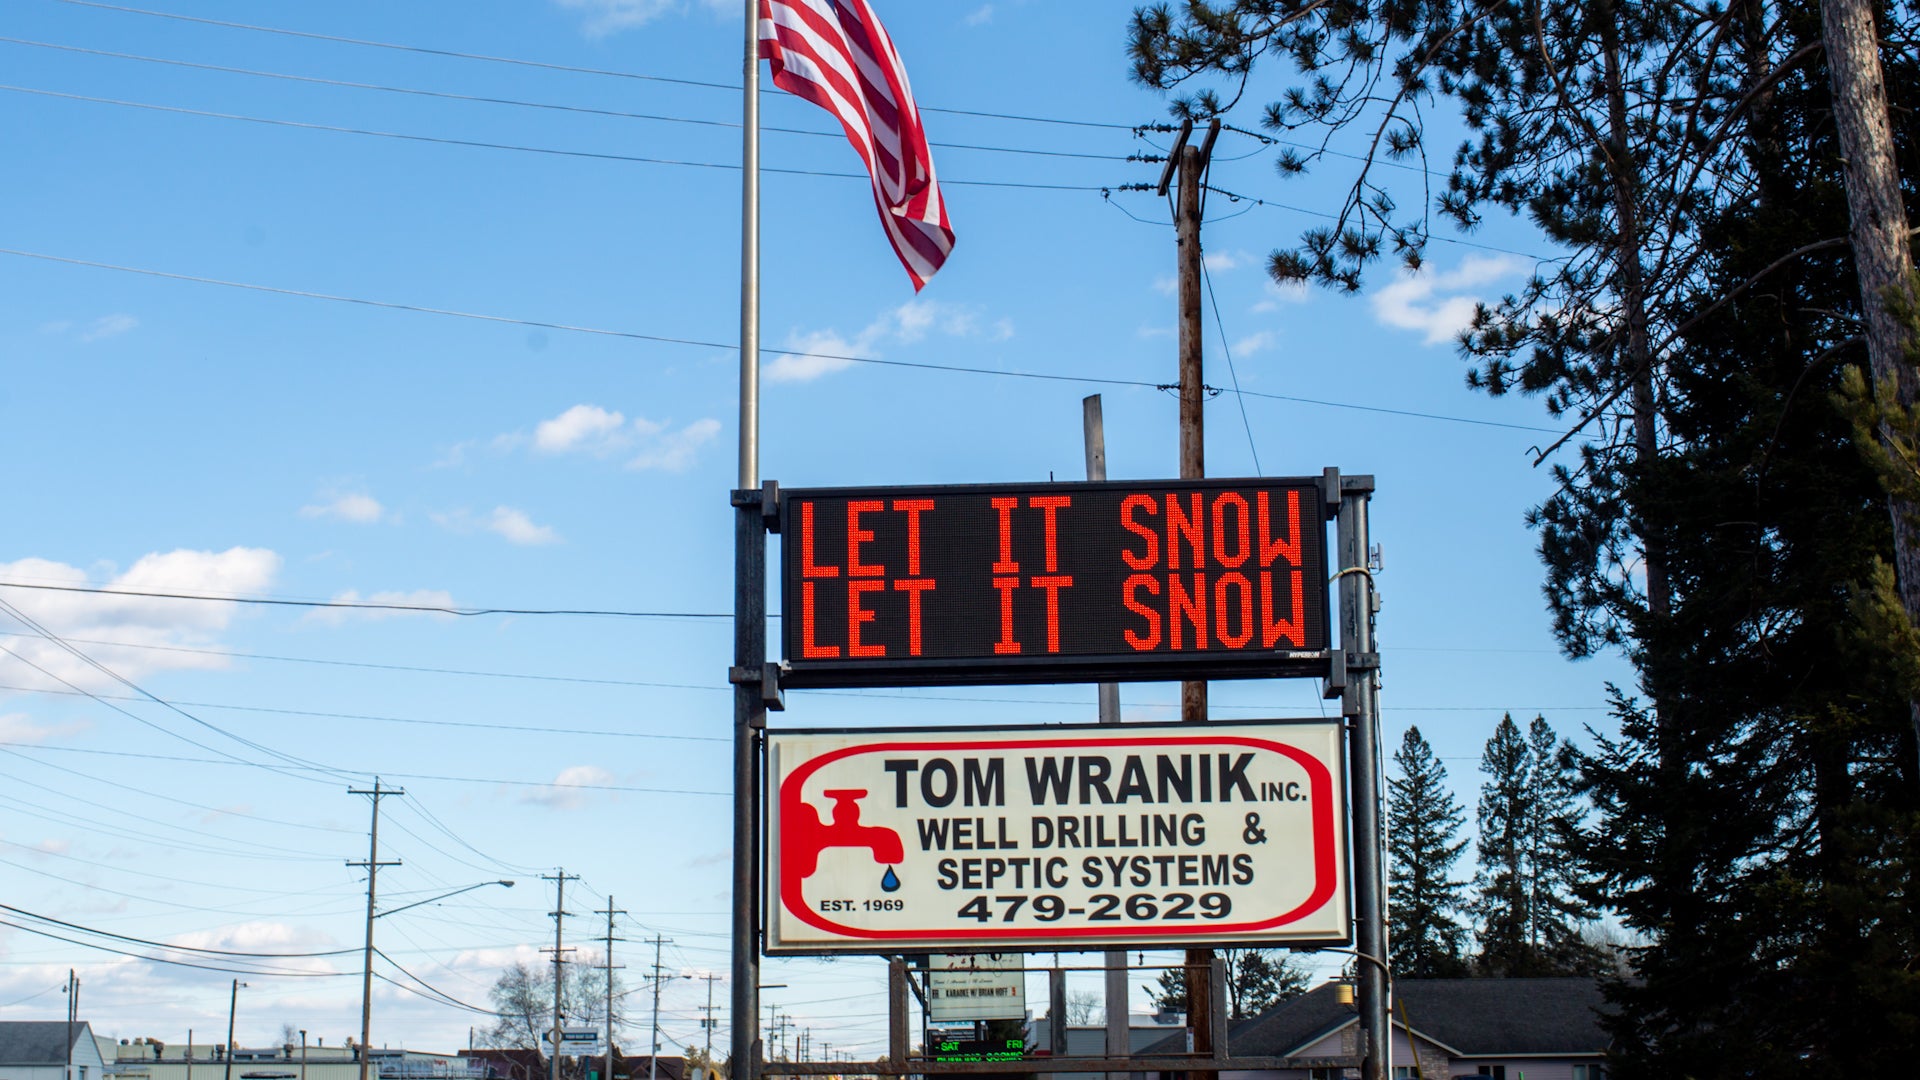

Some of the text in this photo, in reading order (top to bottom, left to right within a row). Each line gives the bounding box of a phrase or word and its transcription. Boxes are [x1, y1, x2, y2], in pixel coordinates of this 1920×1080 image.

[802, 491, 1301, 578] LET IT SNOW
[803, 571, 1304, 658] LET IT SNOW
[885, 753, 1307, 808] TOM WRANIK INC.
[917, 812, 1267, 850] WELL DRILLING &
[938, 854, 1254, 890] SEPTIC SYSTEMS
[820, 899, 904, 912] EST. 1969
[957, 892, 1232, 923] 479-2629
[946, 988, 969, 998] KARAOKE
[941, 1041, 959, 1051] SAT
[1006, 1040, 1023, 1049] FRI
